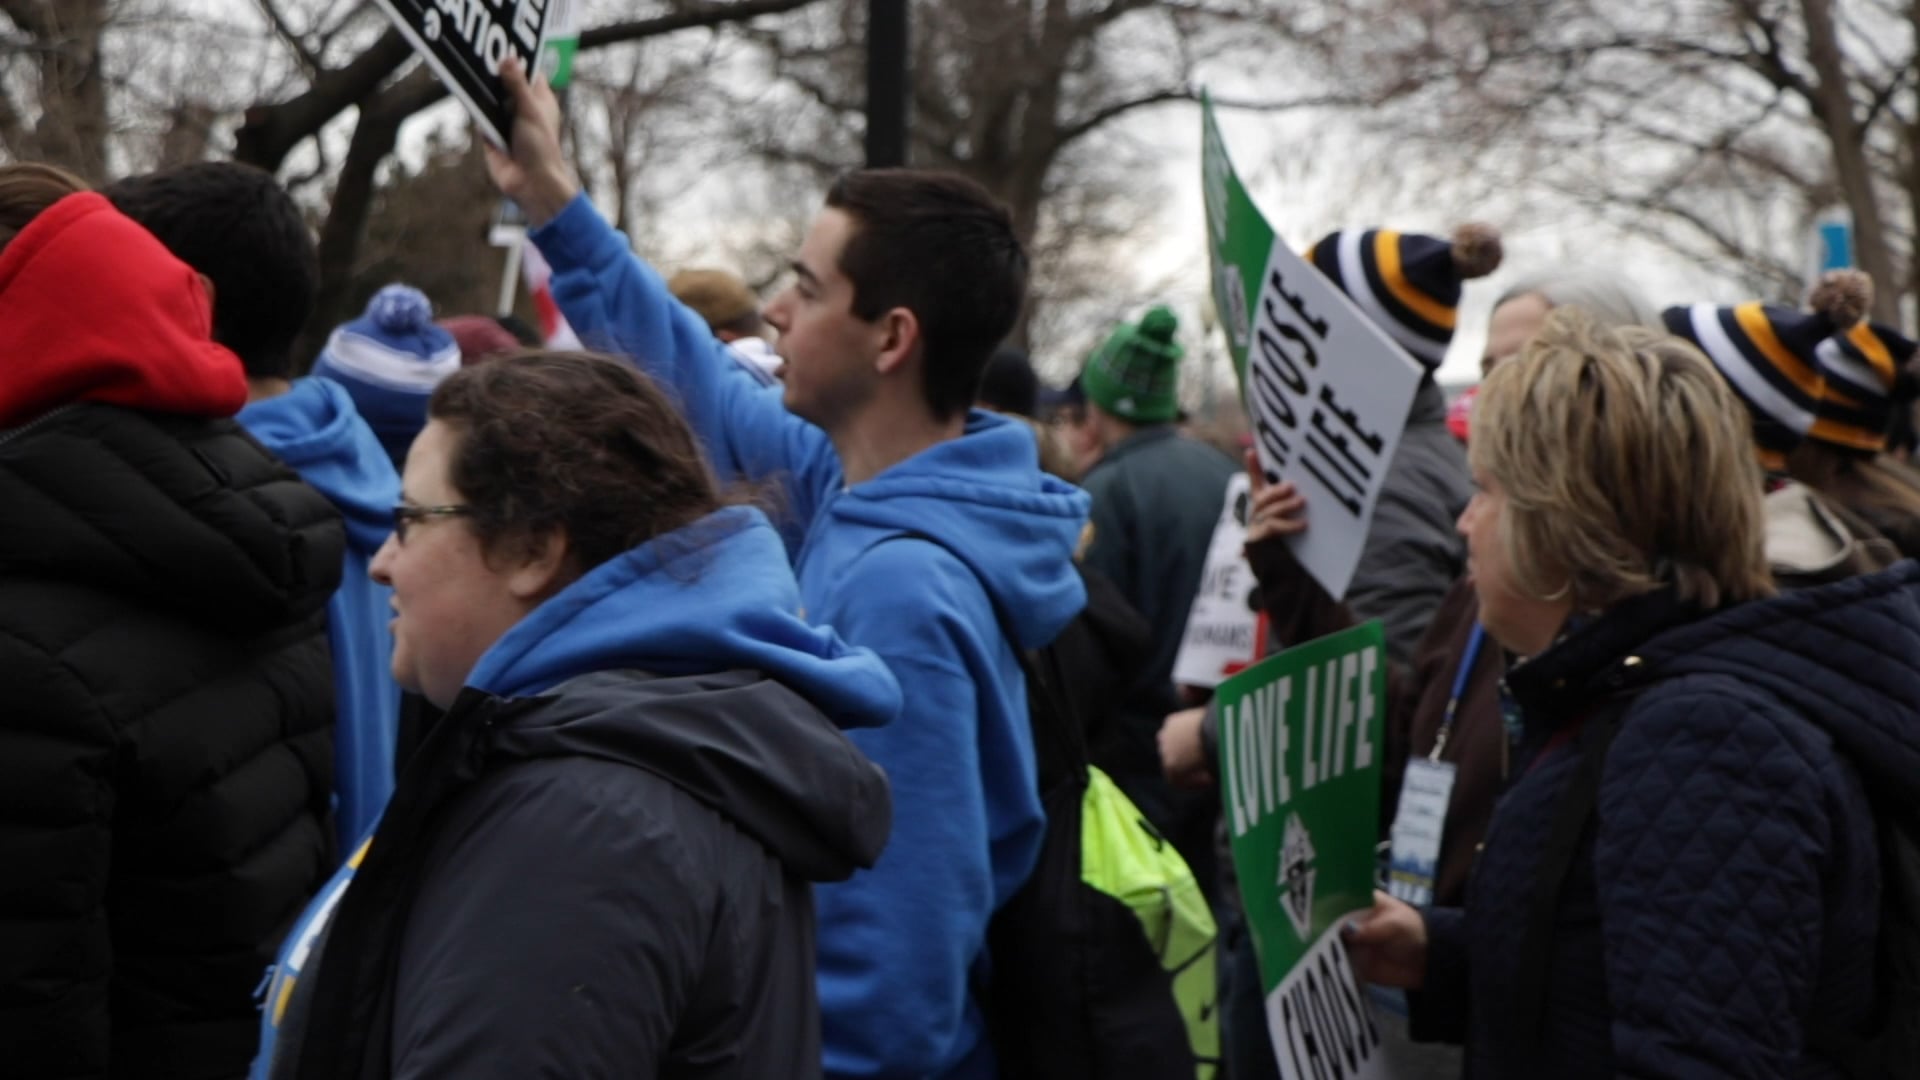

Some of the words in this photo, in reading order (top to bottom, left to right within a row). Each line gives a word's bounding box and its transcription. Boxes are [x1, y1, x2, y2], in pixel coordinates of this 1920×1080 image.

[1298, 383, 1385, 517] LIFE
[1224, 674, 1291, 837] LOVE
[1303, 645, 1377, 790] LIFE
